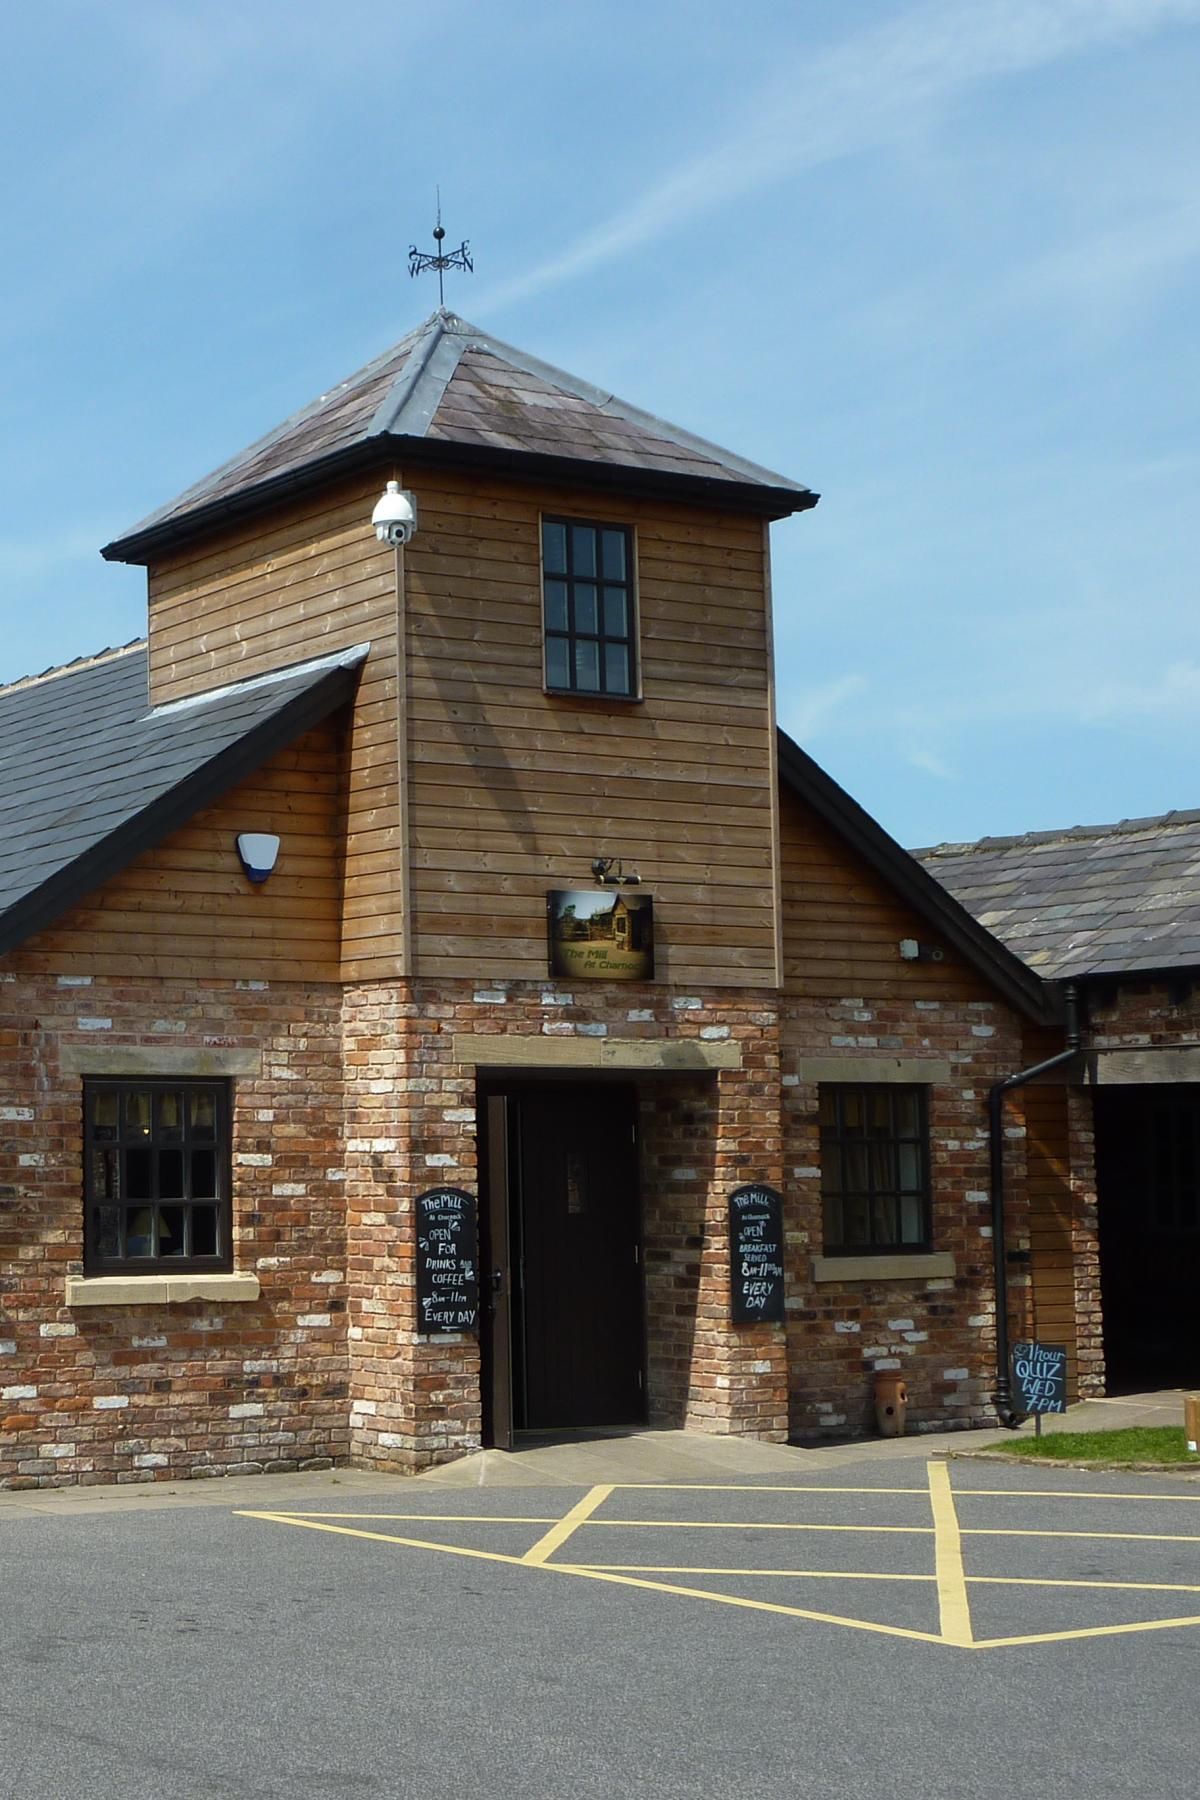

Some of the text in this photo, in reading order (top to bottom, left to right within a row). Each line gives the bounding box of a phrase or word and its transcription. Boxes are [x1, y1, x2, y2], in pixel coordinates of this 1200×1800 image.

[463, 257, 474, 273] N
[587, 950, 608, 959] Mill
[421, 1199, 441, 1211] The
[429, 1228, 452, 1241] OPEN
[743, 1225, 764, 1237] OPEN
[425, 1257, 457, 1270] DRINKS
[431, 1273, 465, 1286] COFFEE
[742, 1281, 774, 1297] EVERY
[745, 1296, 767, 1309] DAY
[456, 1309, 476, 1325] DAY
[1015, 1360, 1063, 1381] QUIZ
[1022, 1379, 1055, 1396] WED
